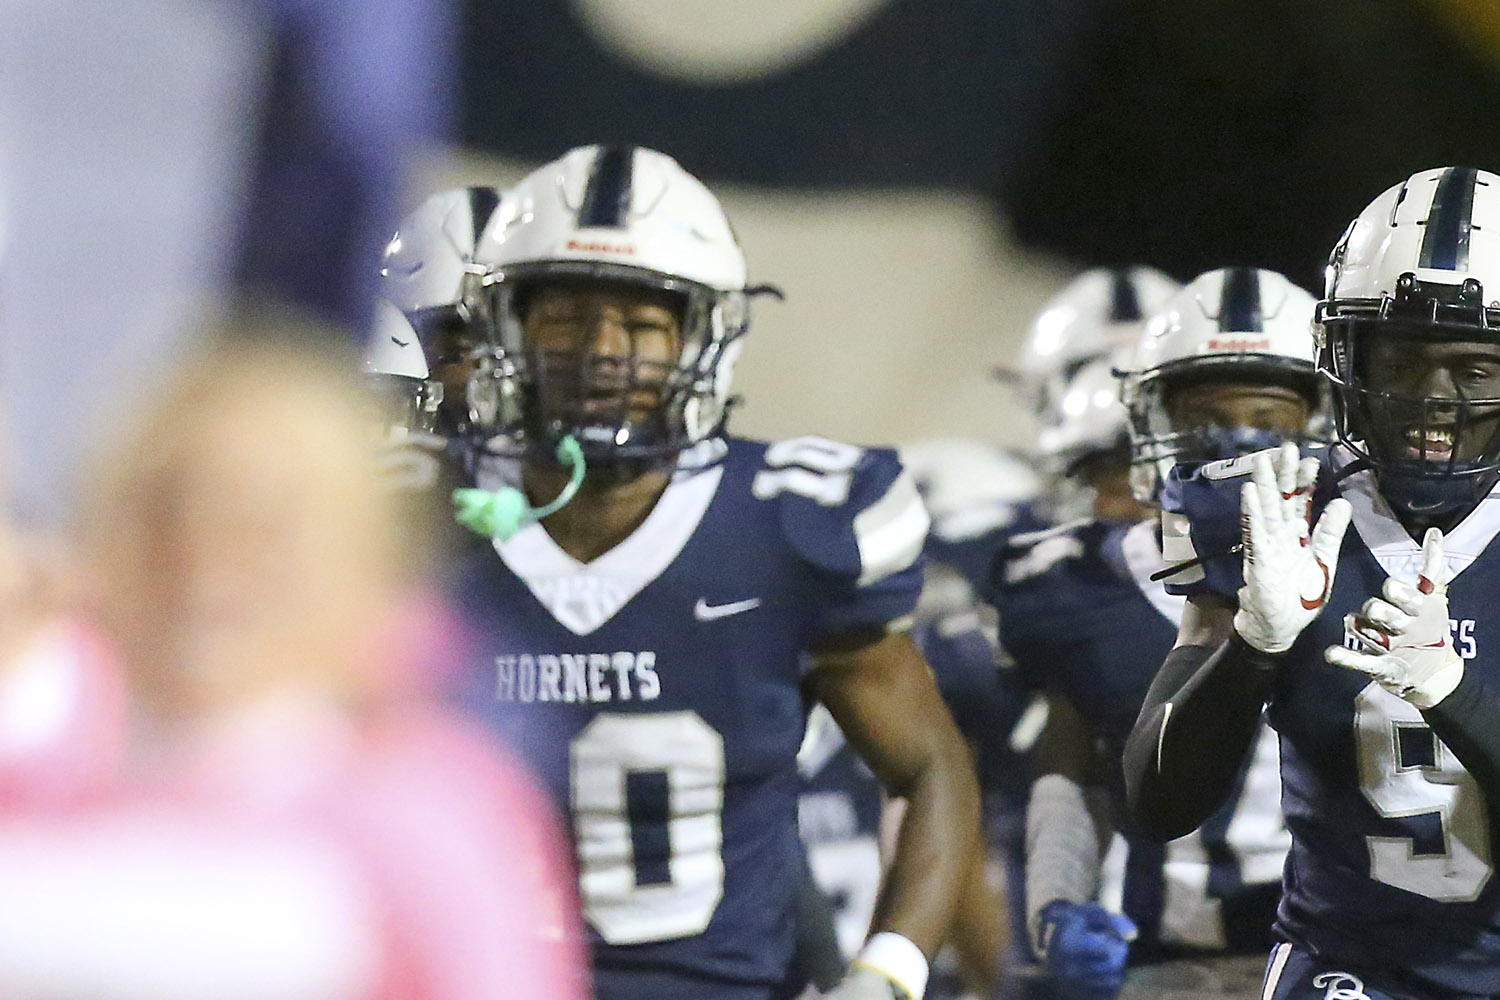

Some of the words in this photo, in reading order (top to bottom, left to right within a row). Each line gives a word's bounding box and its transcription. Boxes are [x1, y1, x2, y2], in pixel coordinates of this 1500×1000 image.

[751, 435, 866, 506] 10
[496, 650, 662, 703] HORNETS
[1353, 680, 1494, 904] 9
